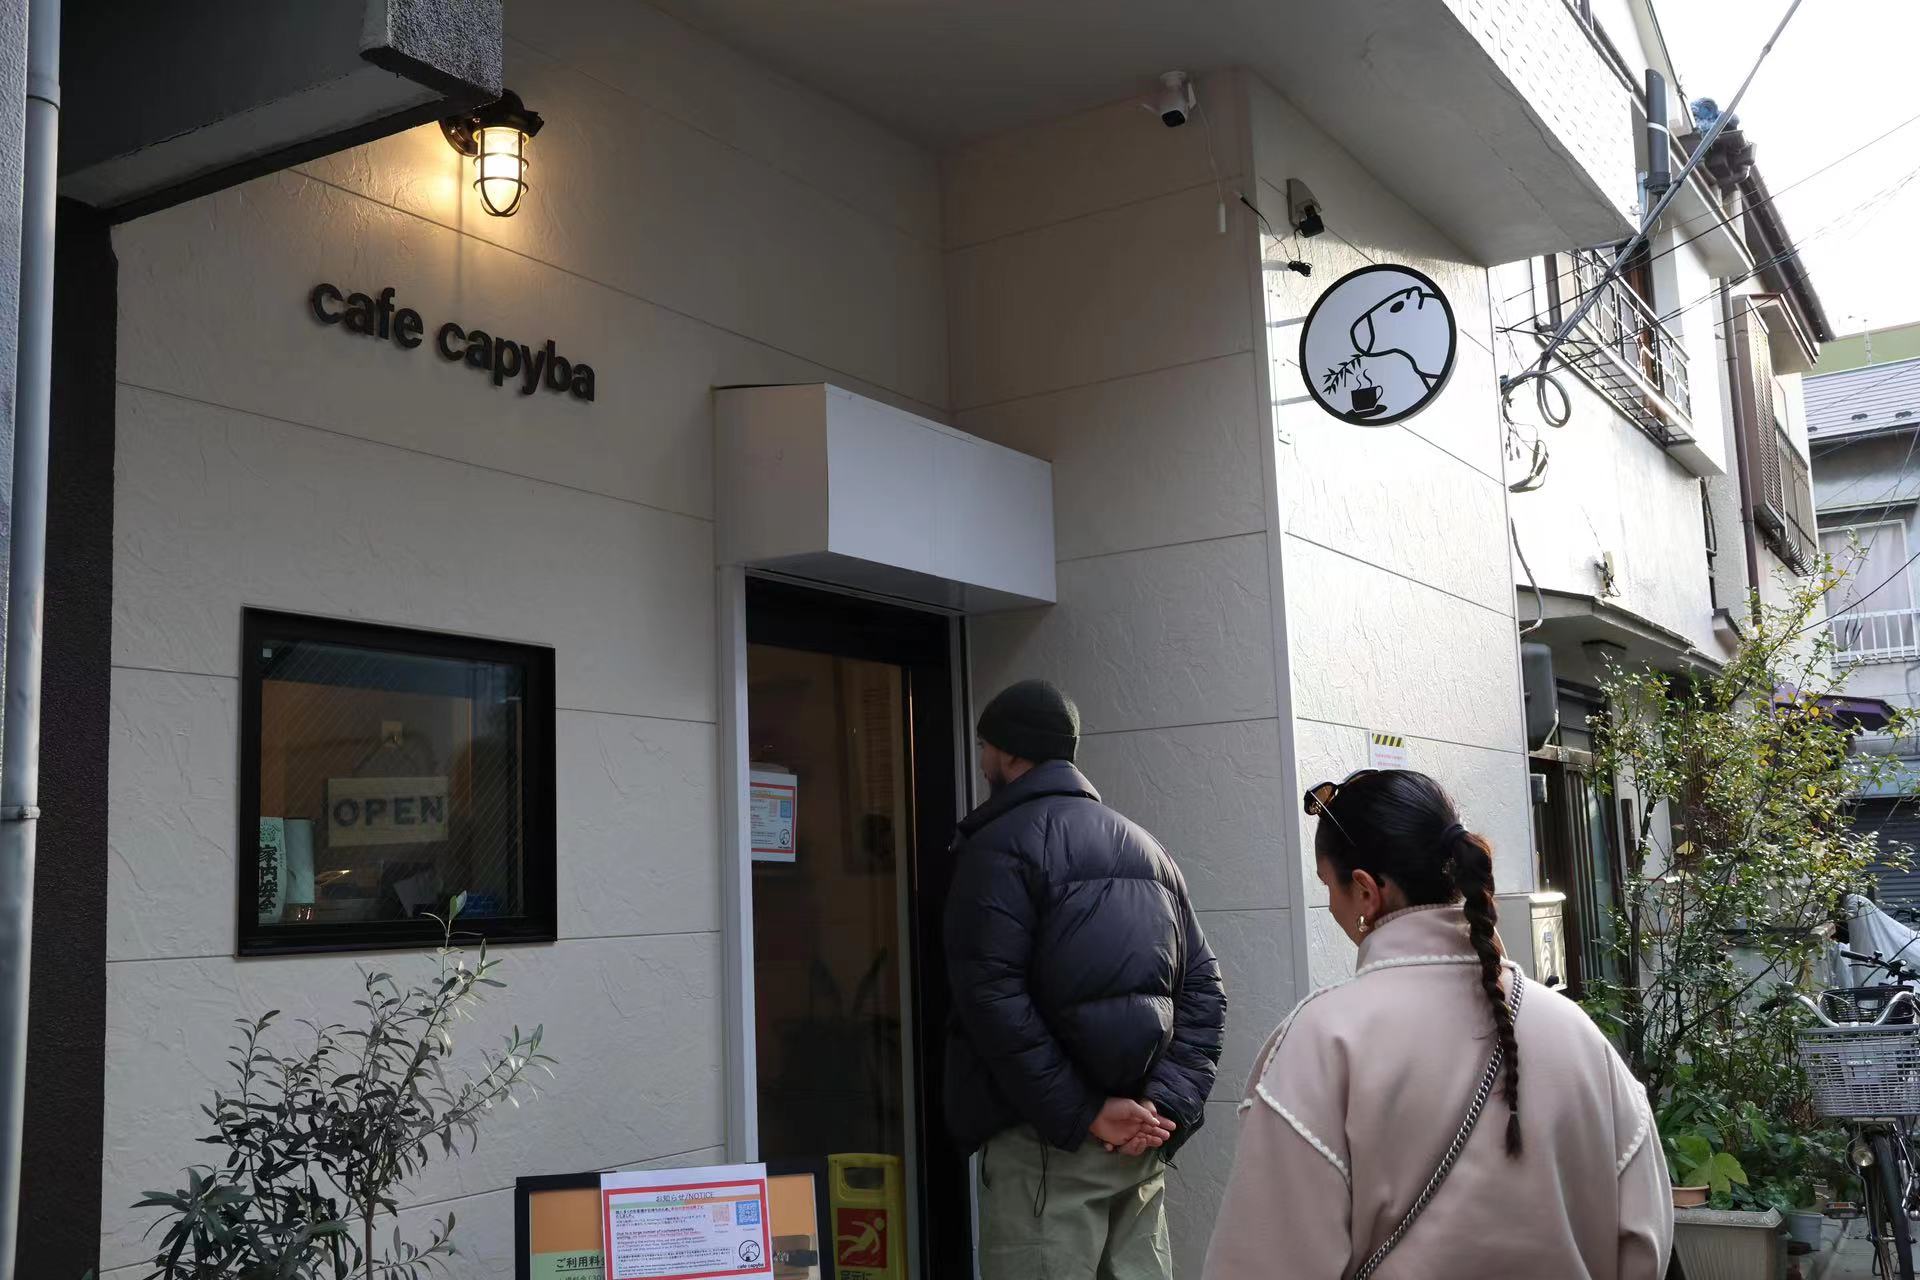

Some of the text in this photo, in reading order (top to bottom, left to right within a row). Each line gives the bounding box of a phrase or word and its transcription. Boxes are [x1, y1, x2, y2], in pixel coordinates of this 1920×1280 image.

[311, 282, 596, 402] cafe capyba
[333, 795, 445, 827] OPEN
